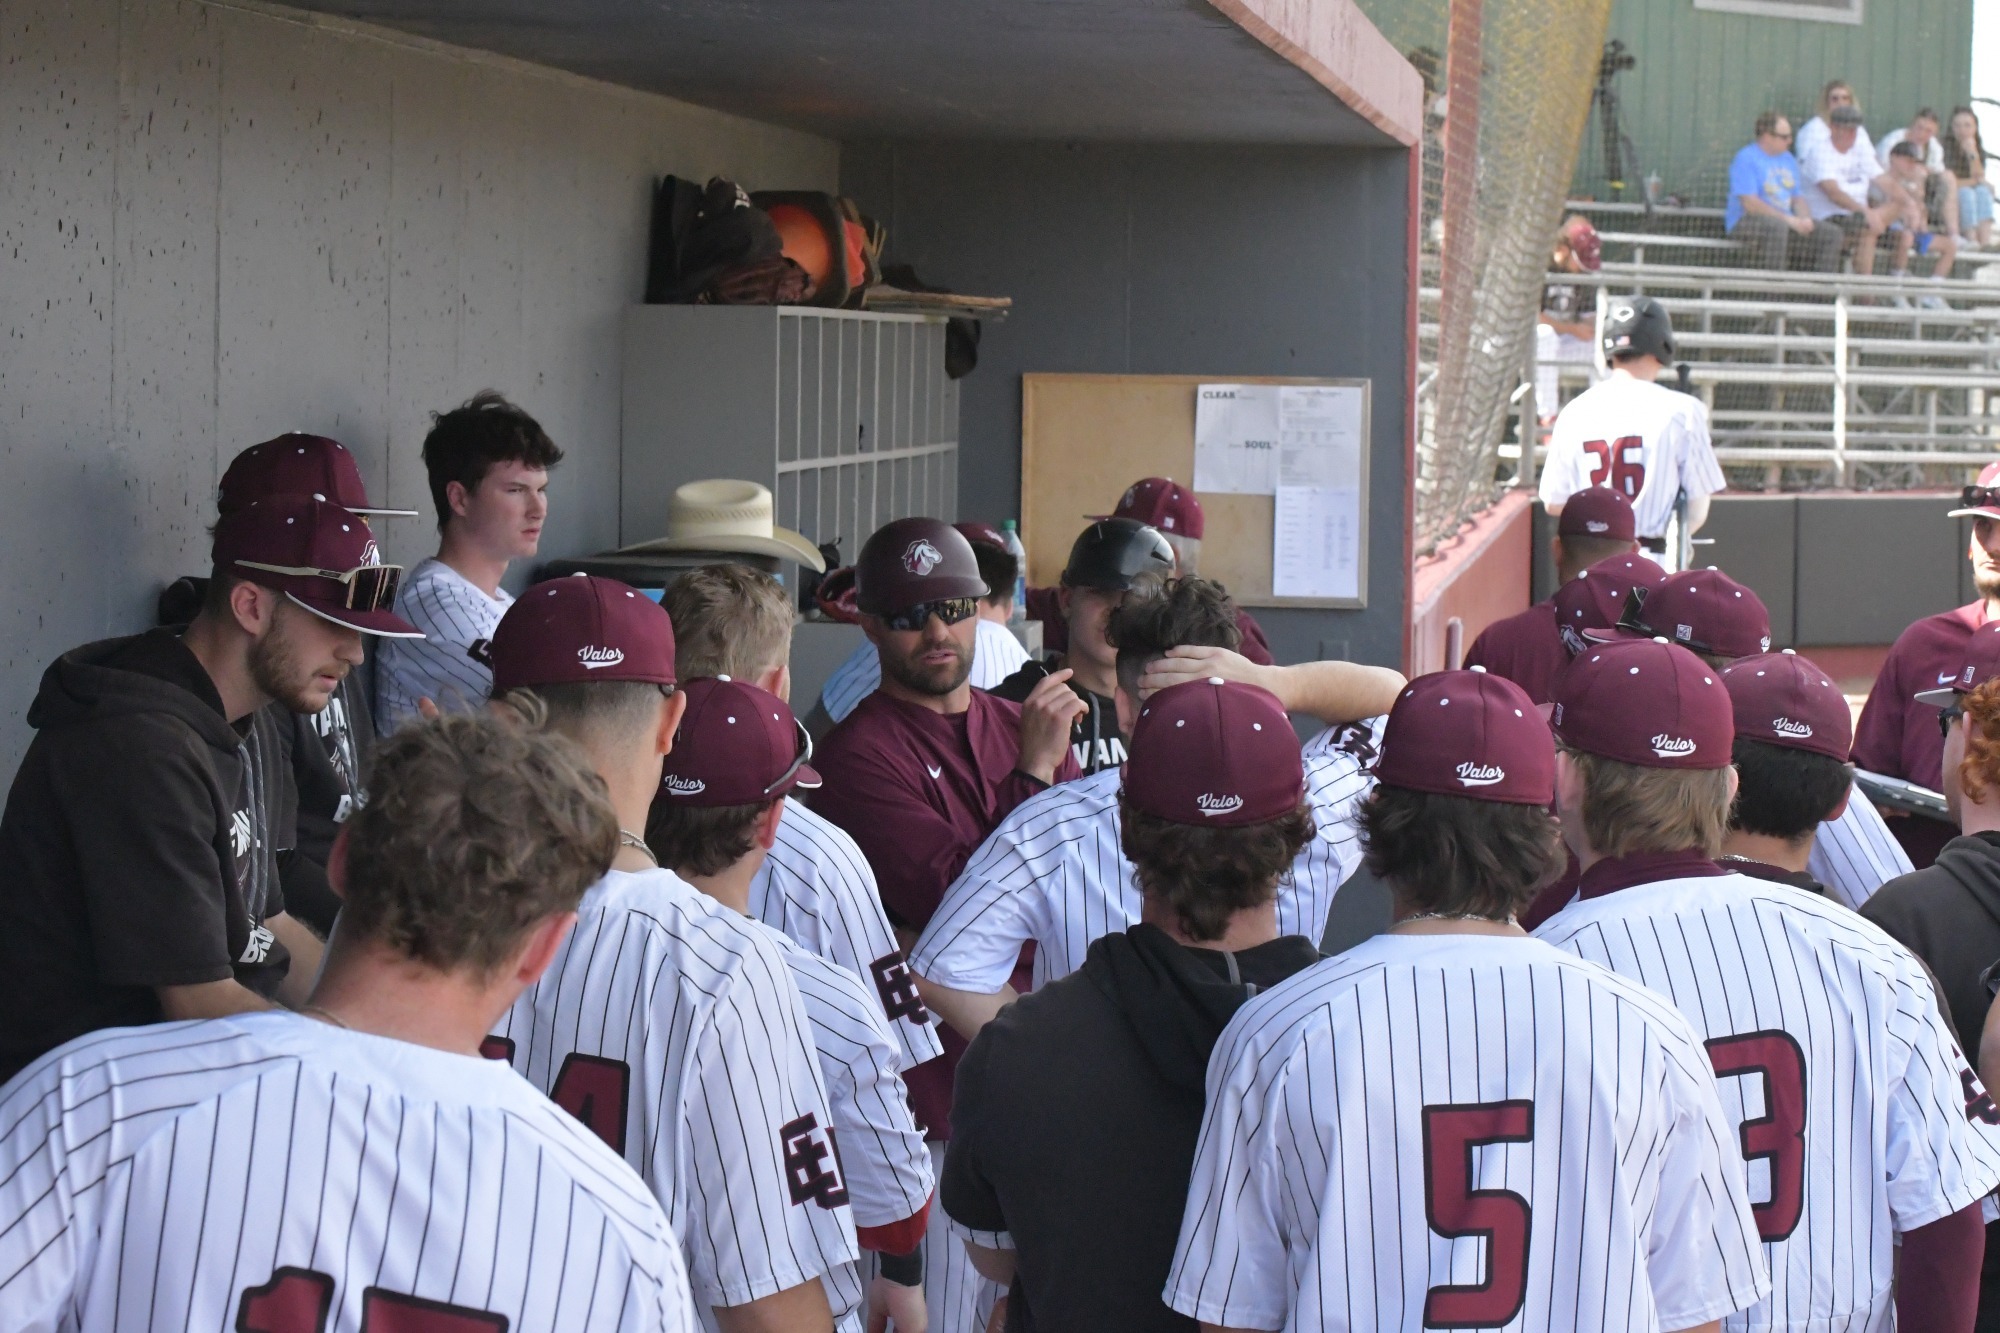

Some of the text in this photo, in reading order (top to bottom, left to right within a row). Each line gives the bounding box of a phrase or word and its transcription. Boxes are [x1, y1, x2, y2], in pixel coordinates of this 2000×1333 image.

[578, 645, 624, 669] Valor
[1773, 717, 1813, 739] Valor
[1651, 733, 1697, 758] Valor
[664, 774, 705, 795] Valor
[1456, 761, 1505, 787] Valor
[1196, 793, 1244, 817] Valor
[1421, 1098, 1534, 1329] 5
